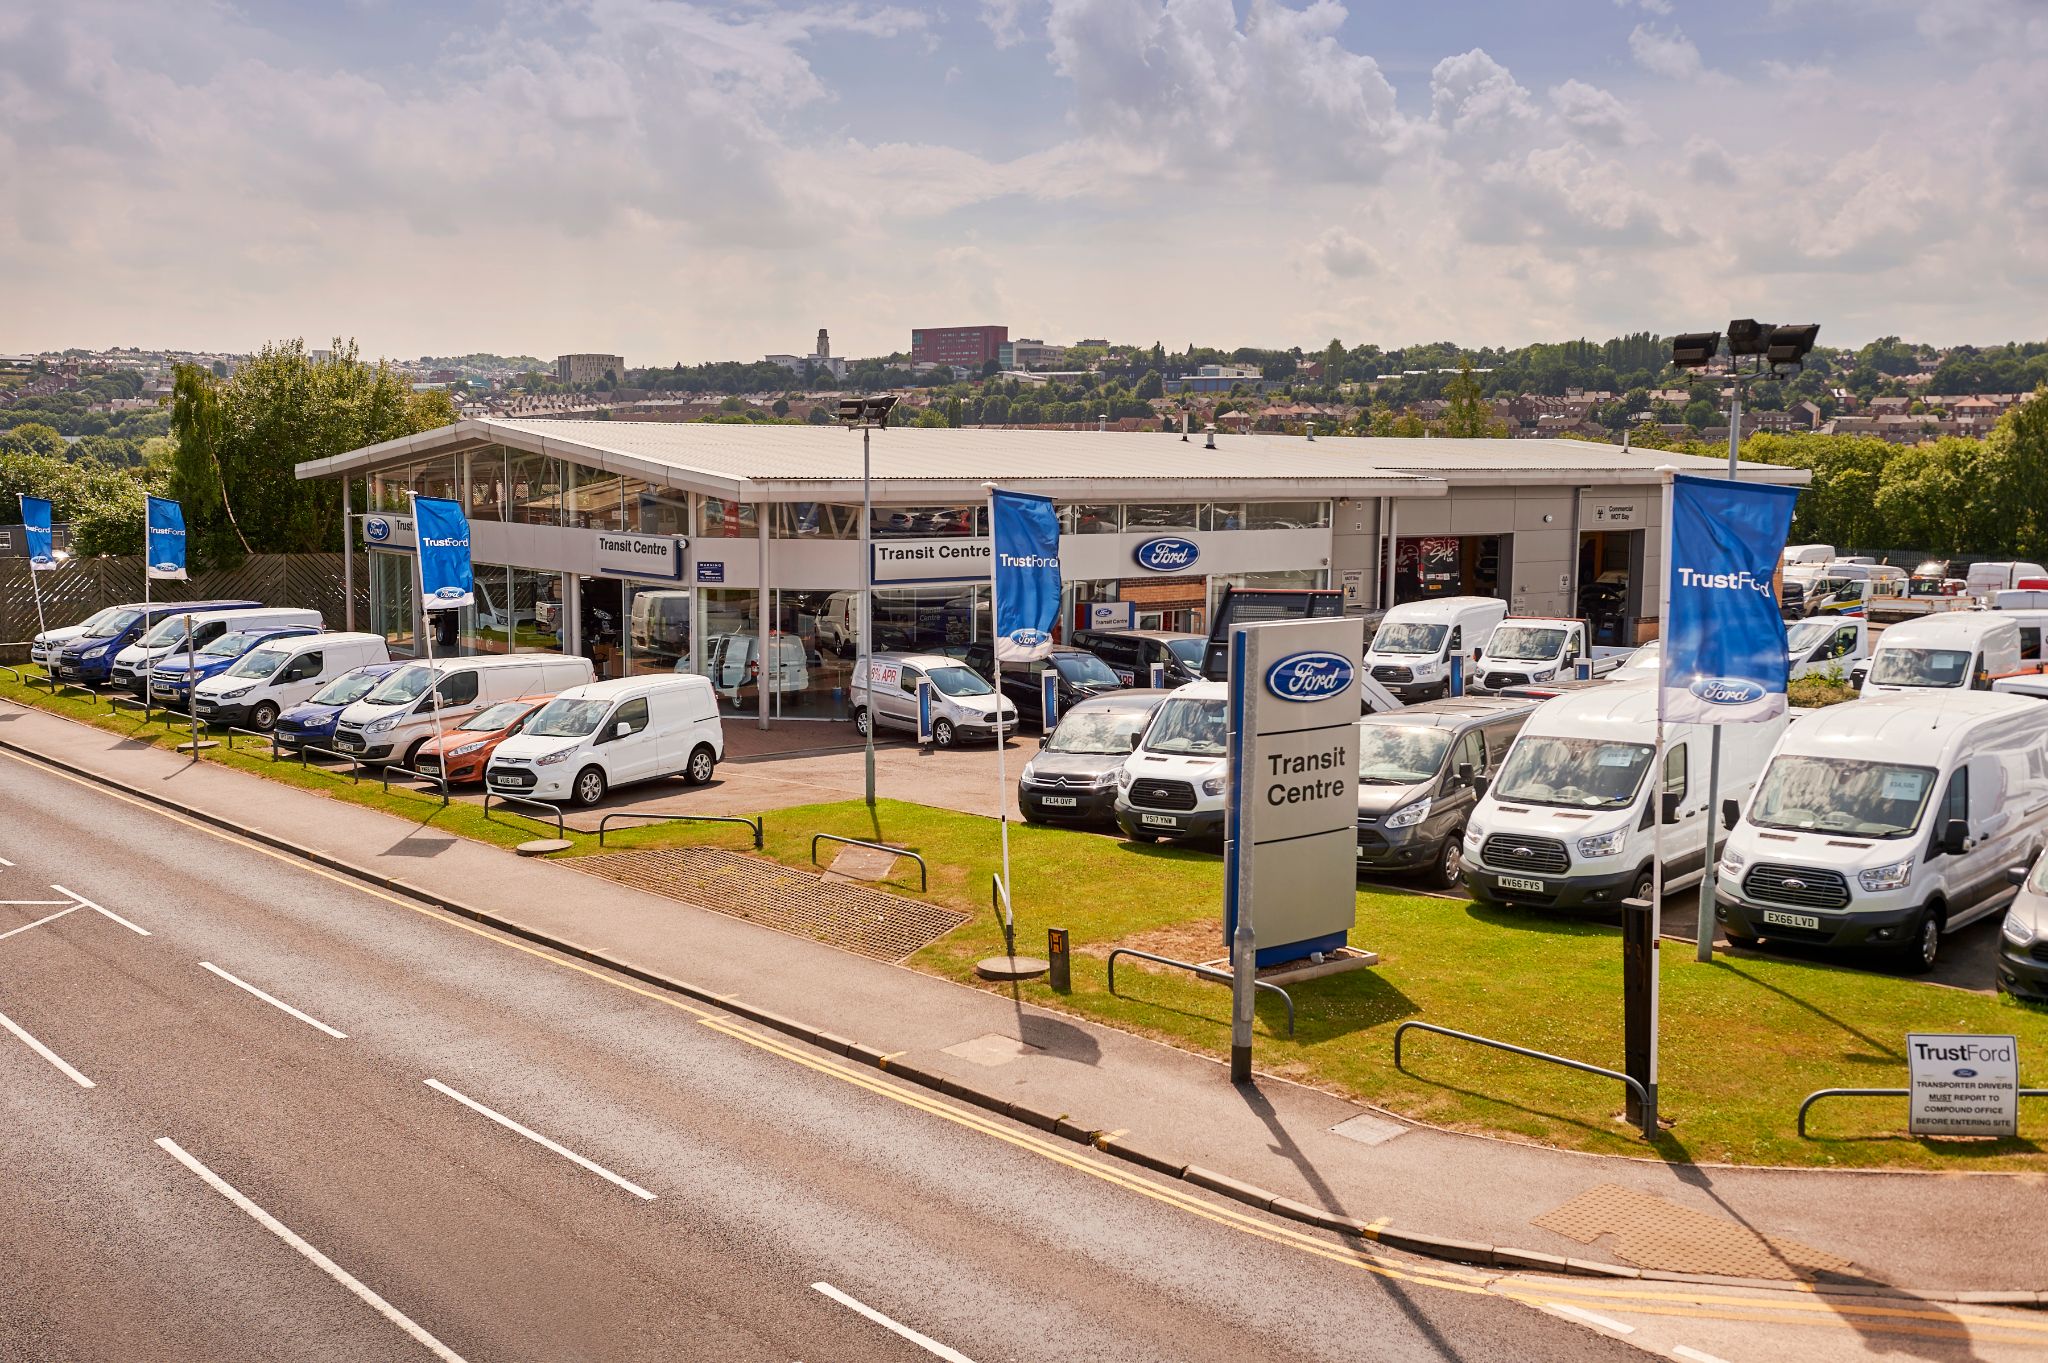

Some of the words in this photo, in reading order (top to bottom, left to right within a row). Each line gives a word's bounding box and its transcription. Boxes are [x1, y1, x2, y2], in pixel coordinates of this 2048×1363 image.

[150, 526, 186, 536] TrustFord
[423, 538, 468, 546] TrustFord
[600, 538, 632, 552] Transit
[634, 540, 667, 556] Centre
[879, 546, 934, 560] Transit
[938, 545, 990, 558] Centre
[1000, 554, 1058, 568] TrustFord
[1678, 568, 1770, 598] TrustFod
[882, 668, 896, 682] APR
[1288, 661, 1340, 692] Ford
[1704, 681, 1750, 701] Ford
[1268, 746, 1346, 776] Transit
[1267, 779, 1344, 806] Centre
[1502, 878, 1522, 888] WV66
[1524, 880, 1540, 890] FVS
[1768, 913, 1792, 924] EX66
[1795, 916, 1814, 927] LVD
[1915, 1044, 2010, 1062] TrustFord
